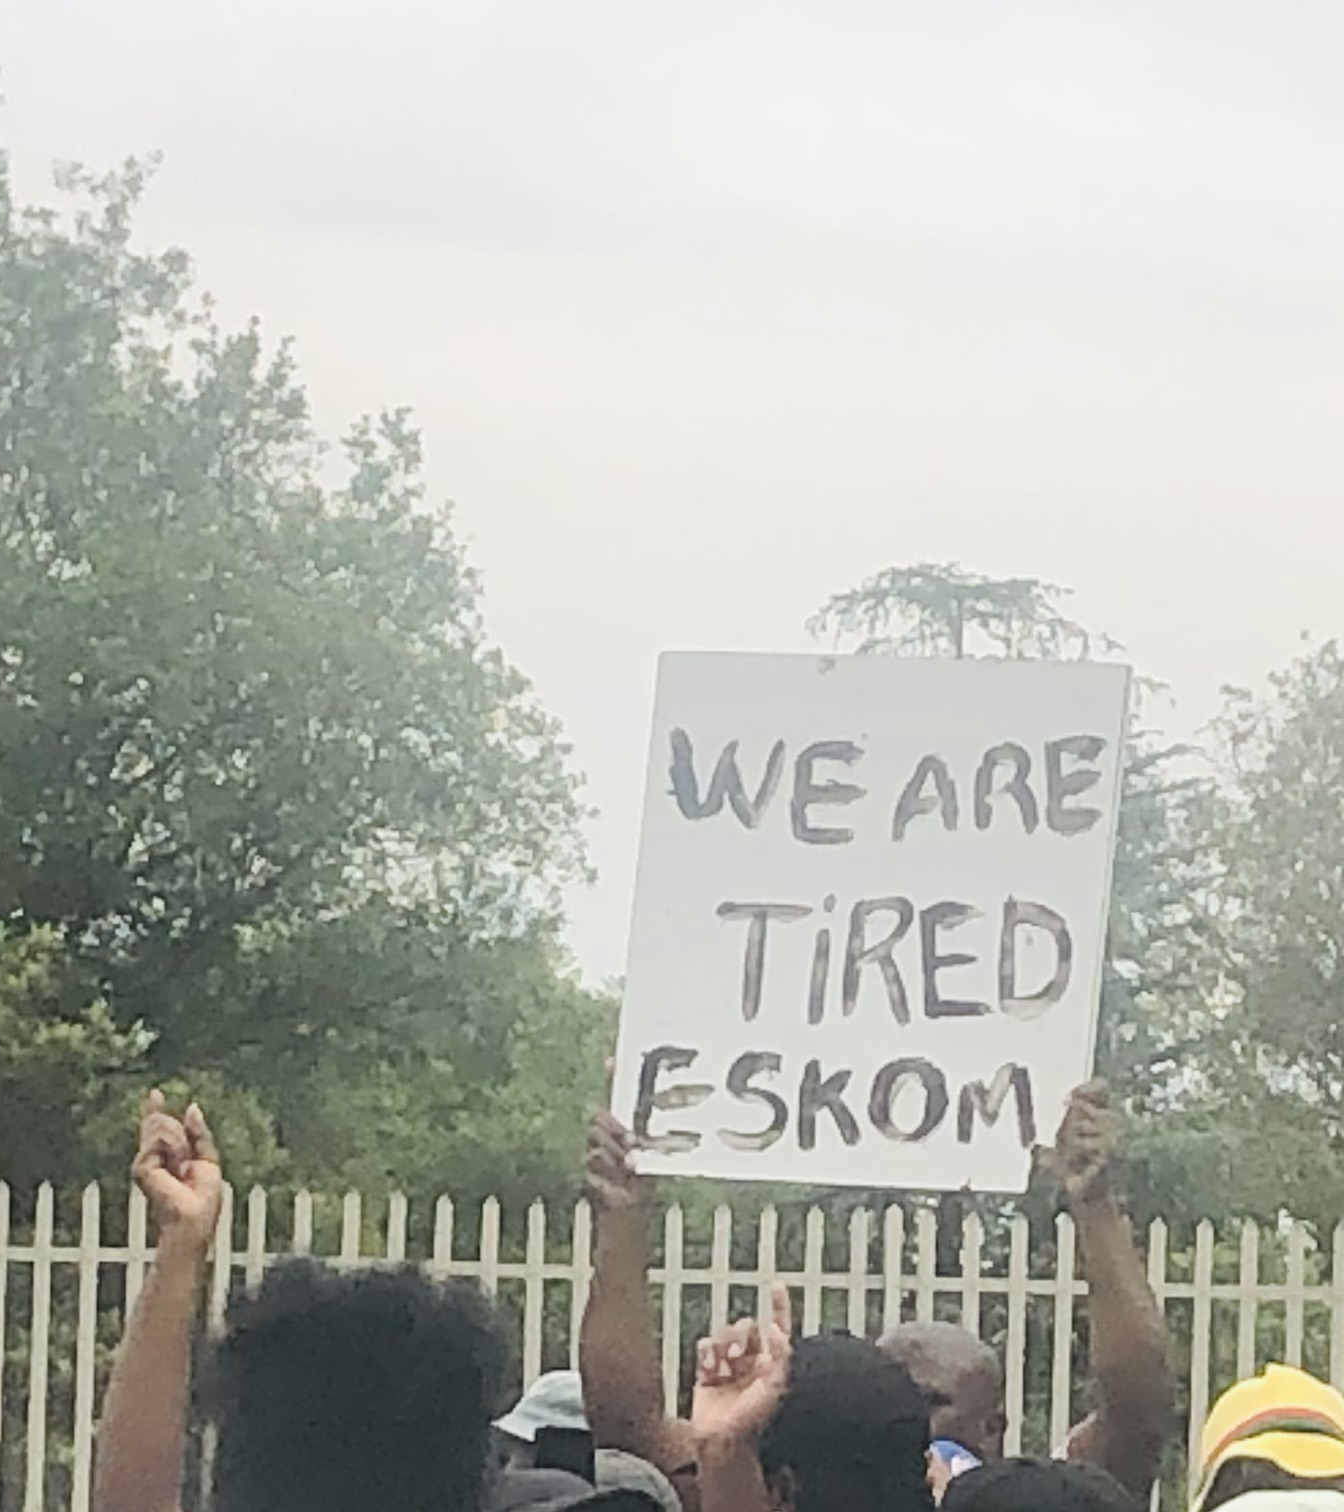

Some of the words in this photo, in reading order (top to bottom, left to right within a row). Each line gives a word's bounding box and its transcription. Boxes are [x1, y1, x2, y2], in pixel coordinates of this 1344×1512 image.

[668, 727, 866, 845] WE
[891, 735, 1107, 841] ARE
[632, 1046, 1037, 1152] ESKOM
